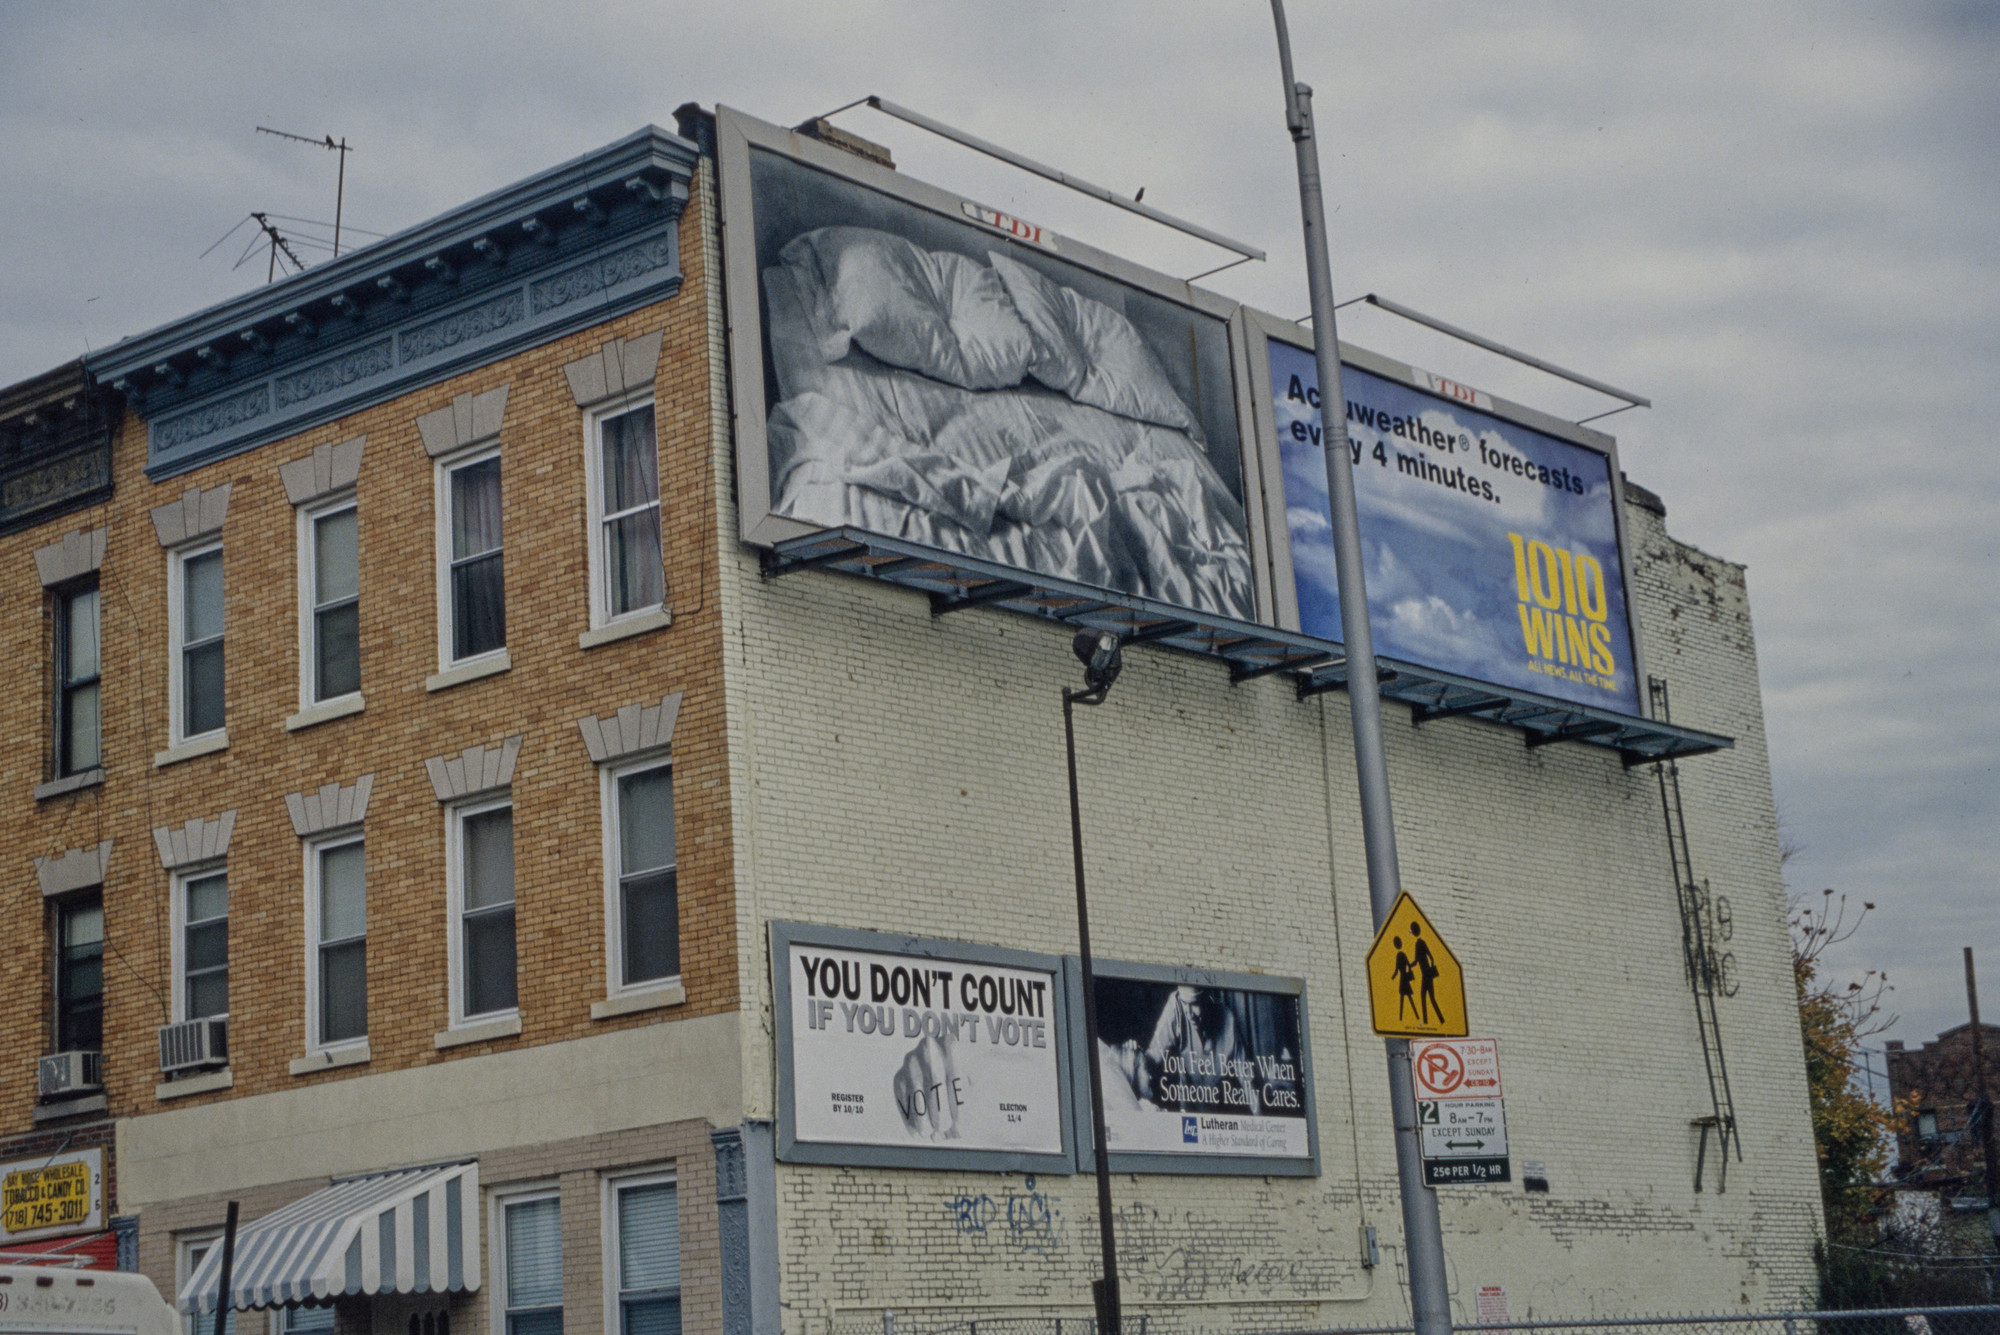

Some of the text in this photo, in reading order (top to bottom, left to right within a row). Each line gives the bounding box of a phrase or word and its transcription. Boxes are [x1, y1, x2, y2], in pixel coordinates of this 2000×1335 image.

[987, 210, 1042, 243] TDI
[1435, 376, 1476, 404] TDI
[1291, 420, 1500, 503] evy 4 minutes.
[1479, 438, 1584, 495] forecasts
[1507, 532, 1607, 623] 1010
[1517, 603, 1615, 676] WINS
[1528, 660, 1542, 673] ALL
[1569, 670, 1583, 683] ALL
[800, 955, 1046, 1018] YOU DON'T COUNT
[807, 999, 1047, 1049] IF YOU DON'T VOTE
[1160, 1050, 1296, 1081] You Feel Better When
[831, 1093, 864, 1103] REGISTER
[898, 1077, 964, 1121] VOTE
[1160, 1076, 1300, 1108] Someone Really Cares.
[833, 1105, 864, 1114] BY 10/10
[1000, 1103, 1027, 1112] ELECTION
[1007, 1114, 1022, 1122] 11/4
[1422, 1100, 1436, 1123] 2
[1201, 1117, 1239, 1130] Lutheran
[1432, 1127, 1495, 1137] EXCEPT SUNDAY
[44, 1164, 83, 1181] WHOLESALE
[94, 1174, 100, 1184] 2
[1433, 1167, 1450, 1177] 25¢
[1452, 1166, 1469, 1176] PER
[1489, 1164, 1501, 1175] HR
[47, 1181, 73, 1200] CANDY
[6, 1199, 83, 1228] (718) 745-3011
